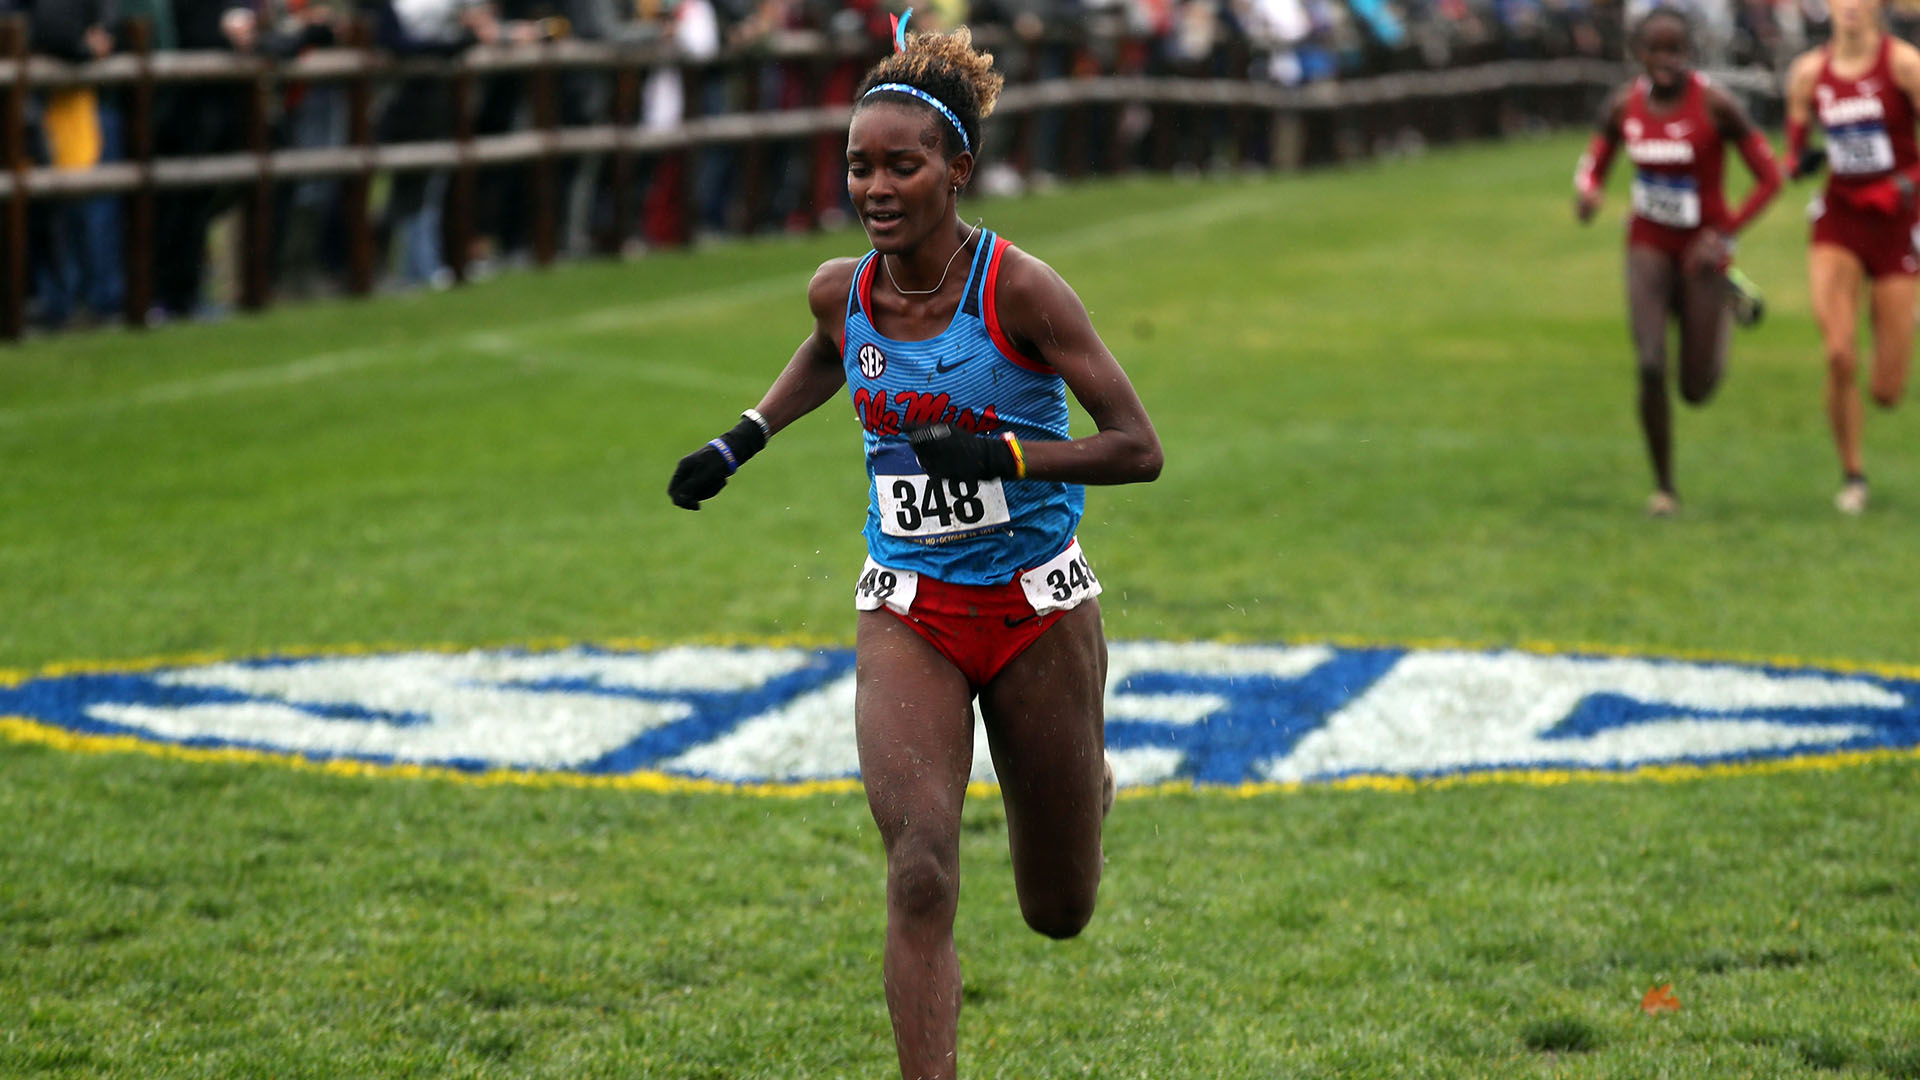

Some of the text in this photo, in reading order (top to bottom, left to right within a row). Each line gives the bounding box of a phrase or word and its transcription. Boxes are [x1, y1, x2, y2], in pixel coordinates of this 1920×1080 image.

[860, 345, 884, 377] SEC
[854, 387, 900, 436] Ole
[892, 479, 985, 531] 348
[855, 567, 897, 600] 48
